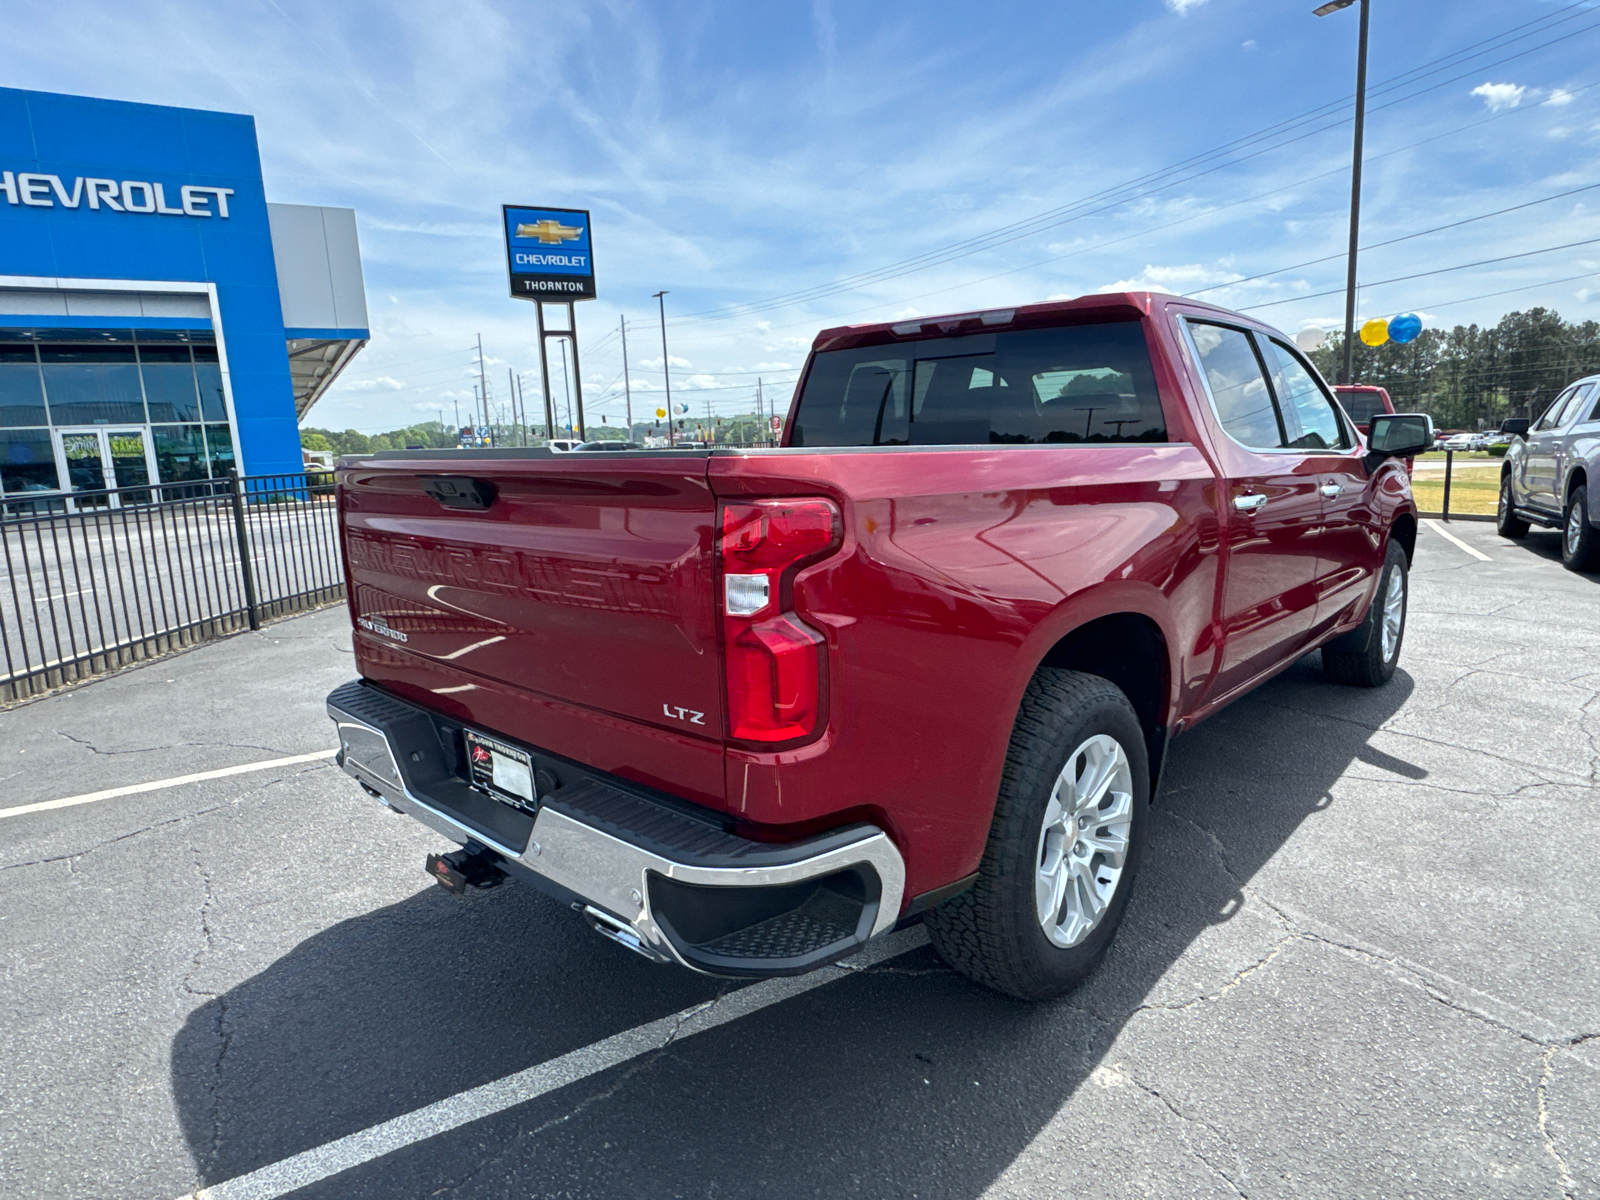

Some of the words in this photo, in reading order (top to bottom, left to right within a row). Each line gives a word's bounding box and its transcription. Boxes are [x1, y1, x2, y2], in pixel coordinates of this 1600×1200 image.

[0, 171, 235, 218] HEVROLET
[515, 253, 586, 267] CHEVROLET
[524, 280, 584, 292] THORNTON
[357, 617, 408, 642] SILVERADO
[662, 703, 706, 725] LTZ
